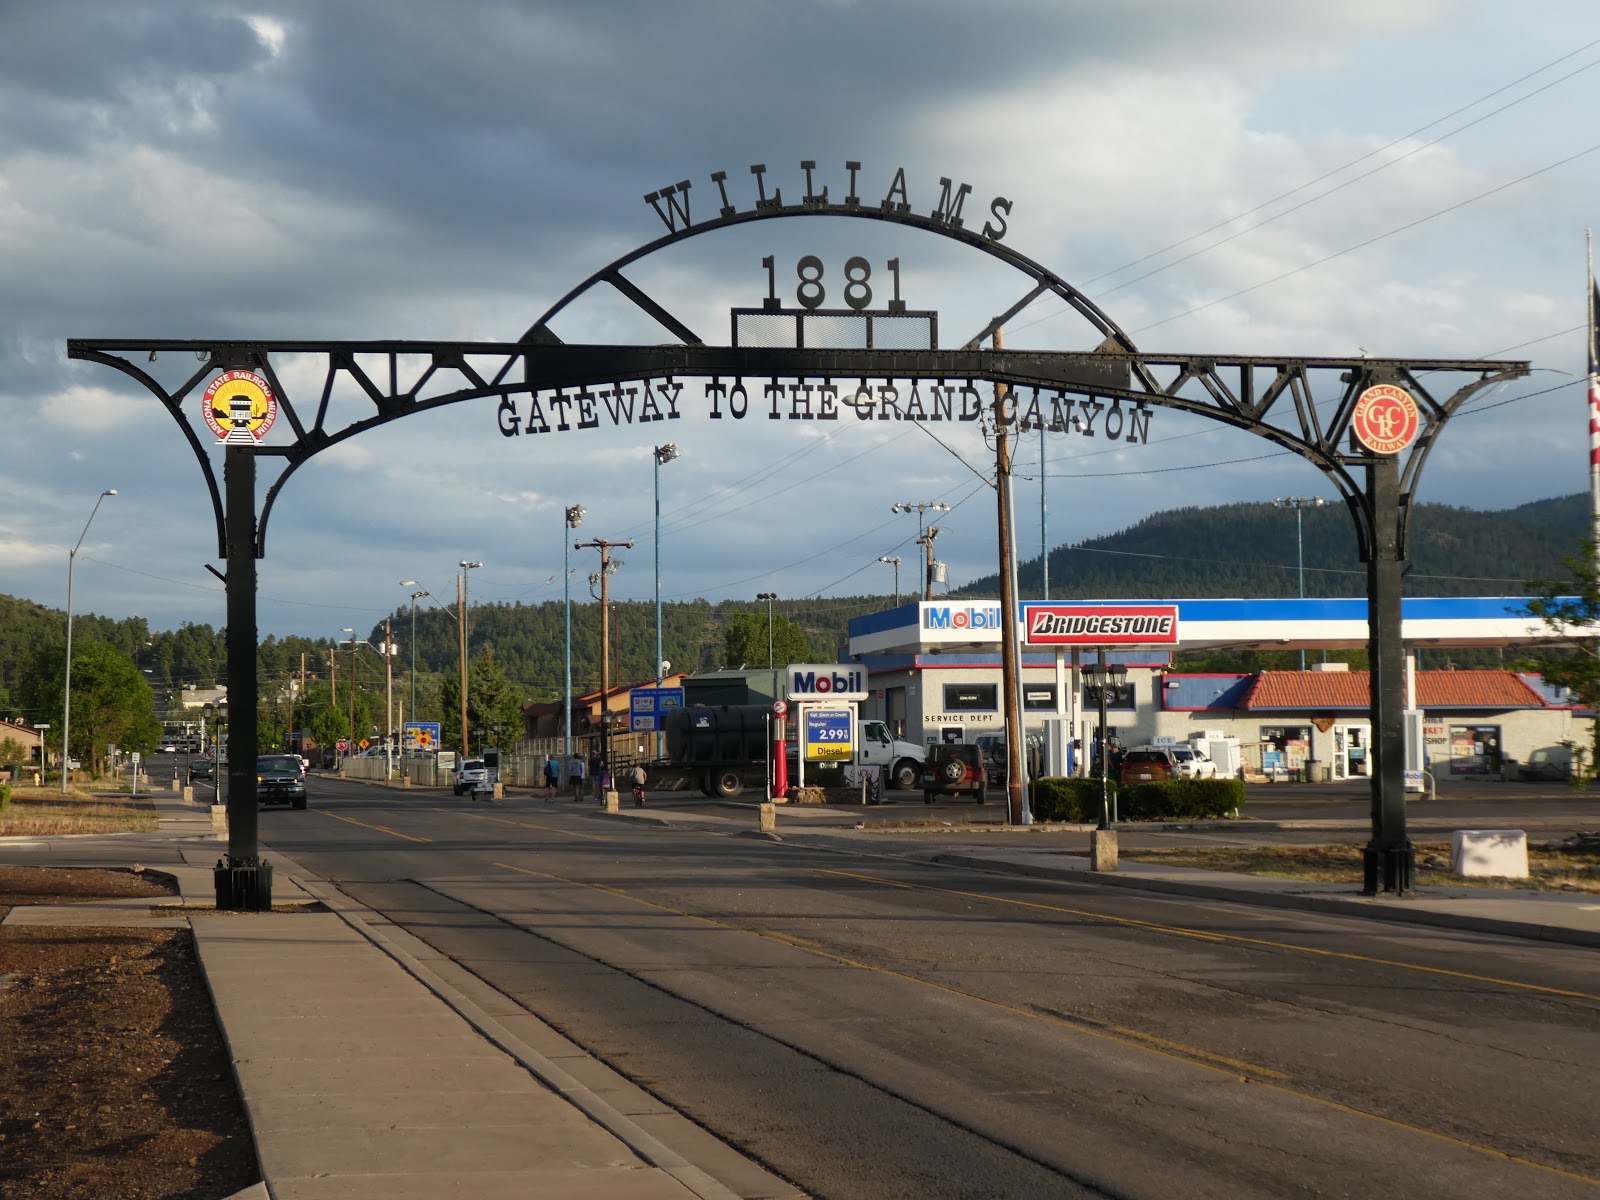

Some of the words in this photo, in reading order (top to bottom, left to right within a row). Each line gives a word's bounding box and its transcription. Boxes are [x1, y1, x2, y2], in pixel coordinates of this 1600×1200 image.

[643, 160, 1014, 242] WILLIAMS
[761, 255, 906, 312] 1881
[207, 373, 231, 396] STATE
[233, 371, 272, 397] RAILROAD
[496, 380, 685, 438] GATEWAY
[705, 381, 749, 420] TO
[764, 382, 839, 420] THE
[856, 384, 982, 422] GRAND
[1004, 390, 1154, 446] CANYON
[1356, 388, 1382, 417] GRAND
[1383, 387, 1416, 418] CANYON
[203, 399, 225, 434] ARIZONA
[255, 400, 275, 435] MUSEUM
[1364, 436, 1406, 450] RAILWAY
[924, 607, 1001, 629] Mobil
[1032, 612, 1173, 636] BRIDGESTONE
[794, 671, 862, 693] Mobil
[820, 730, 844, 740] 2.99
[817, 747, 843, 755] Diesel
